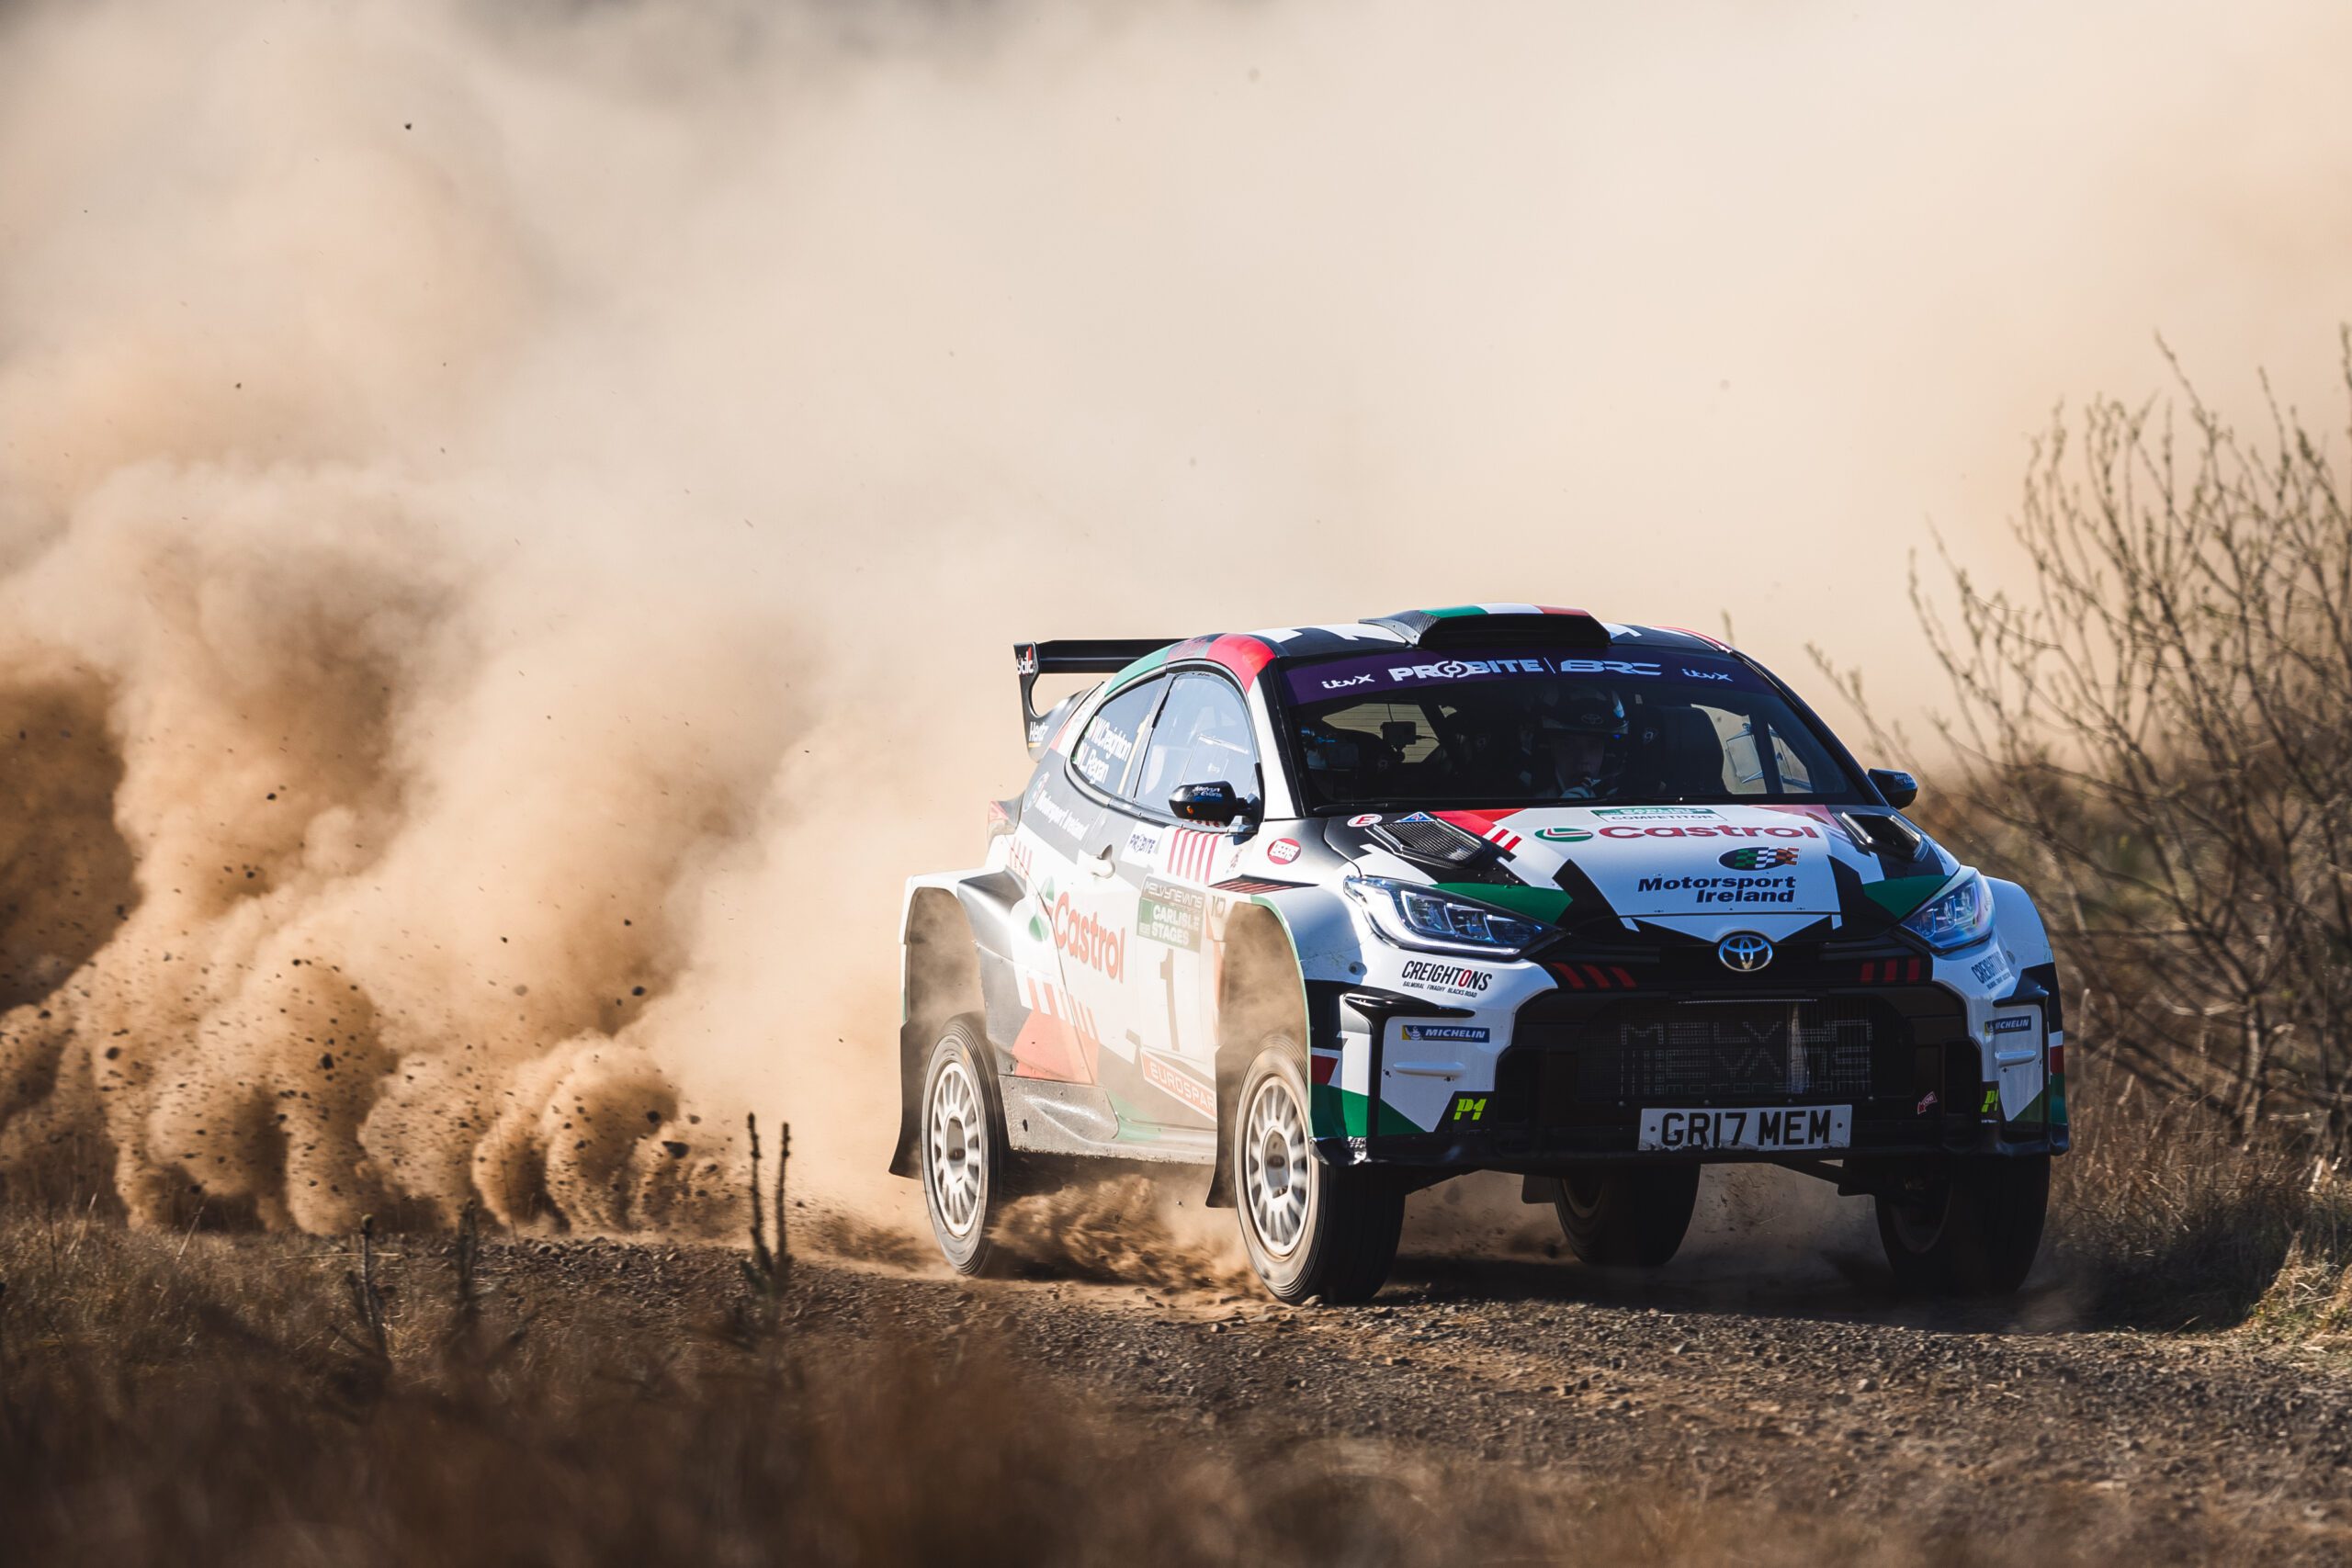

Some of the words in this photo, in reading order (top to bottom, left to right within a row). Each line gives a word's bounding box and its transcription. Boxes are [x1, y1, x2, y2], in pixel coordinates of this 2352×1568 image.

[1321, 673, 1375, 689] itvX
[1387, 658, 1544, 682] PROBITE
[1355, 816, 1376, 825] E
[1599, 824, 1820, 839] Castrol
[1637, 875, 1796, 893] Motorsport
[1696, 889, 1795, 903] Ireland
[1153, 904, 1201, 932] CARLISLE
[1054, 890, 1125, 985] Castrol
[1151, 919, 1190, 946] STAGES
[1401, 960, 1493, 991] CREIGHTONS
[1159, 948, 1181, 1053] 1
[1425, 1029, 1486, 1039] MICHELIN
[1149, 1060, 1216, 1111] EUROSPAR
[1453, 1098, 1487, 1121] P1
[1660, 1111, 1747, 1147] GR17
[1758, 1109, 1832, 1146] MEM
